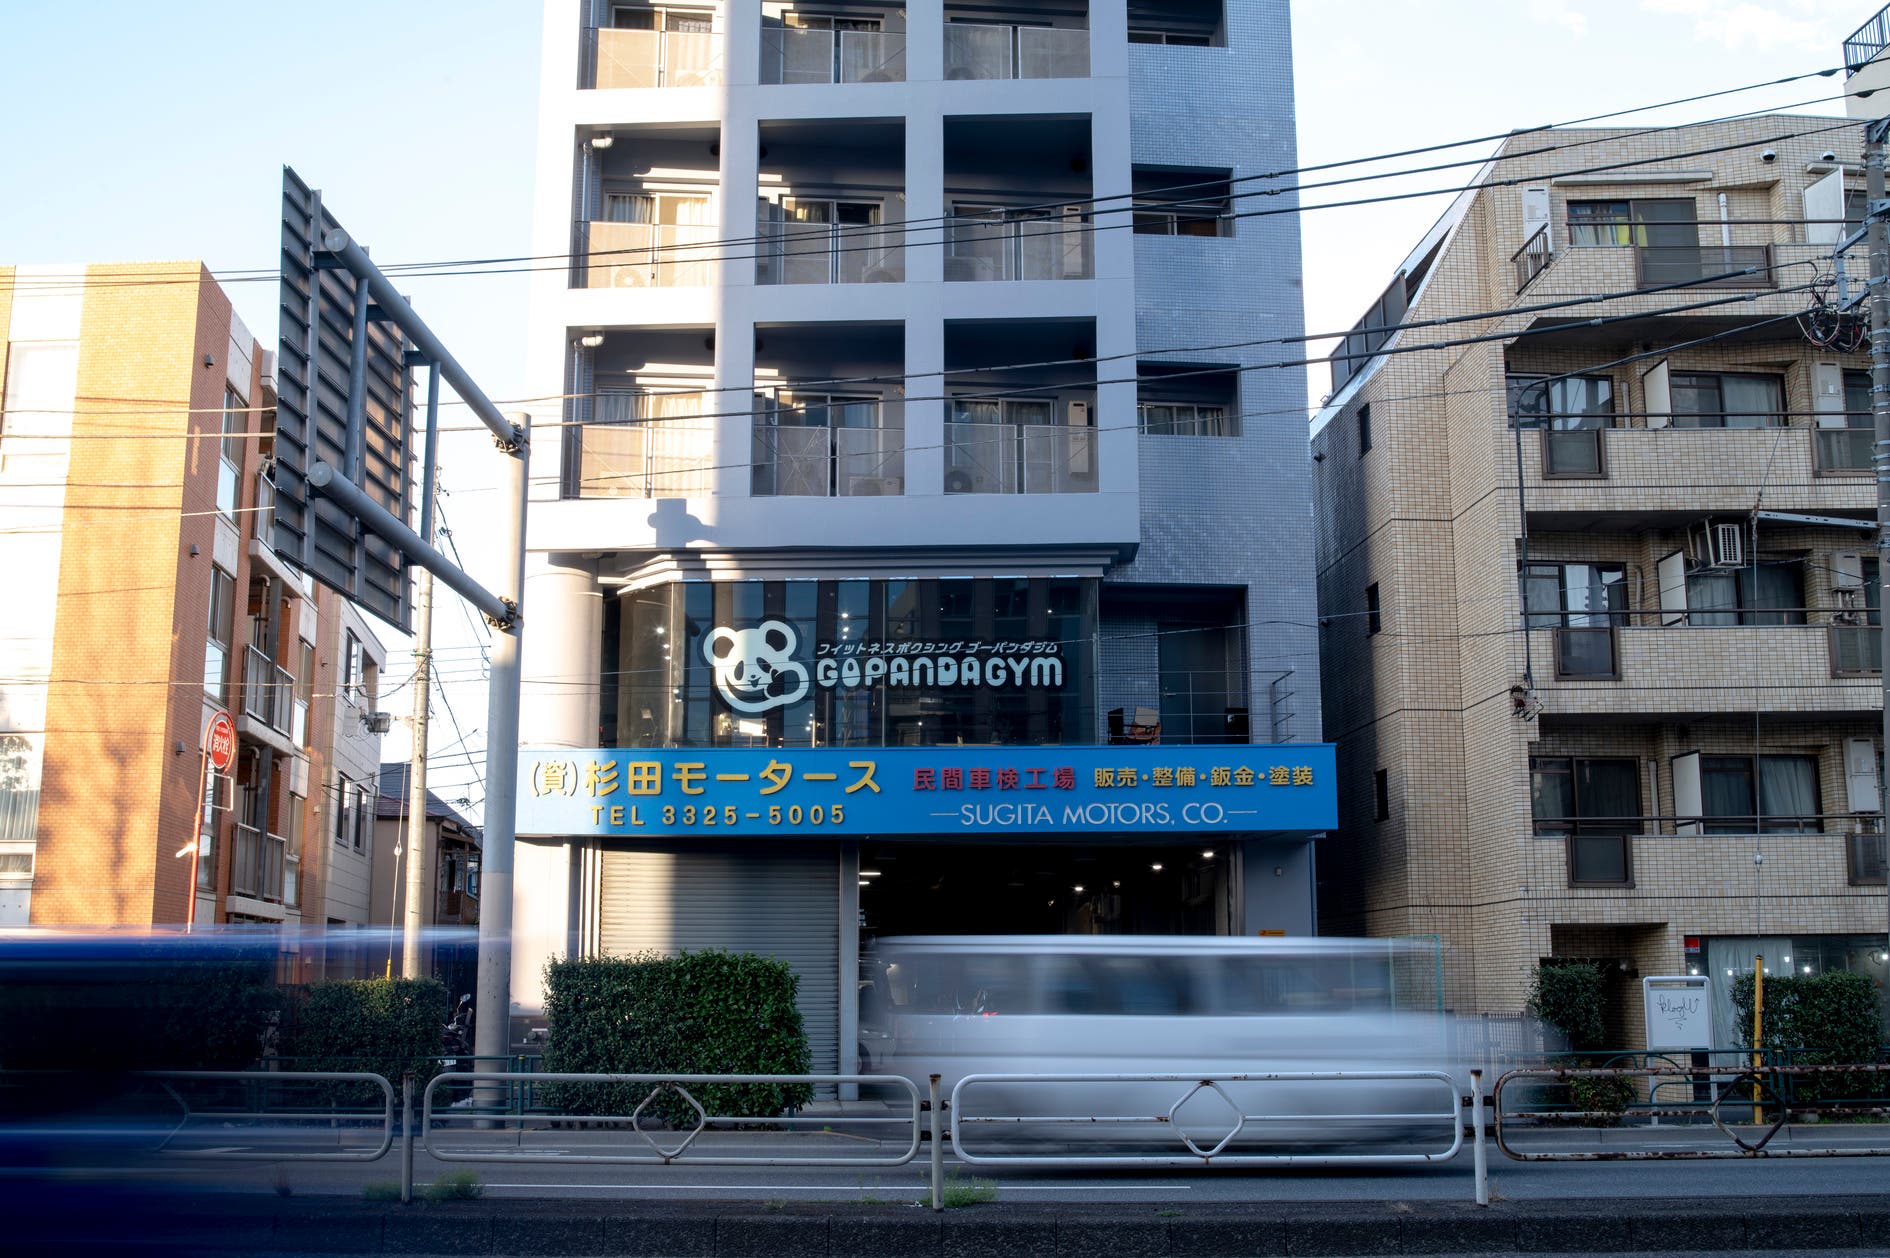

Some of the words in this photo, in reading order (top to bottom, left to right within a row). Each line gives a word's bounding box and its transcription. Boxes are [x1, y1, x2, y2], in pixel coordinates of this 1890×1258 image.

[913, 767, 1076, 791] 民間車検工場
[591, 805, 645, 826] TEL
[662, 804, 845, 826] 3325-5005
[960, 803, 1054, 826] SUGITA
[1182, 802, 1228, 824] CO.
